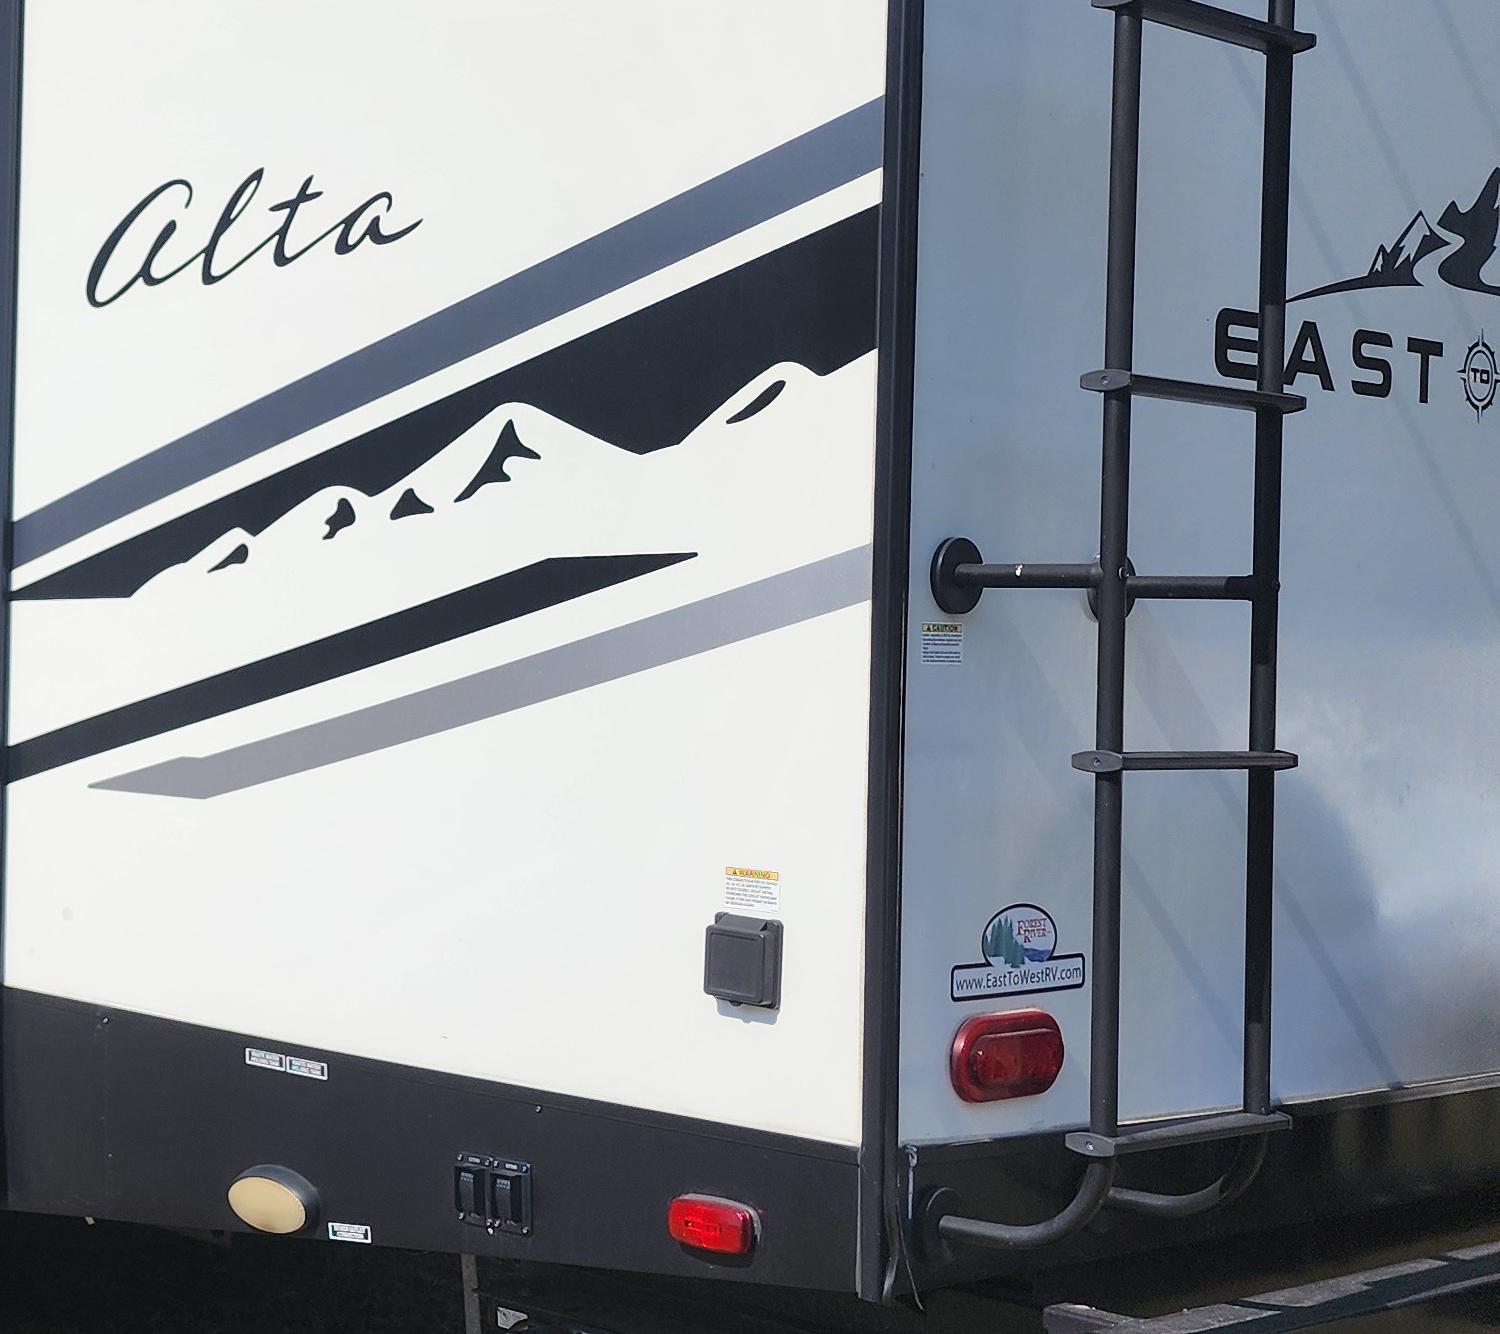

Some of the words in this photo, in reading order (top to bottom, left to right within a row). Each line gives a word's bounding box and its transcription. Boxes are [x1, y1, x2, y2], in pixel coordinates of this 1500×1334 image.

[86, 167, 423, 308] Alta
[1214, 307, 1443, 404] EAST
[1470, 368, 1490, 384] TO
[1016, 918, 1047, 936] FOREST
[1023, 927, 1047, 943] RIVER
[956, 966, 1082, 991] www.EastToWestRV.com
